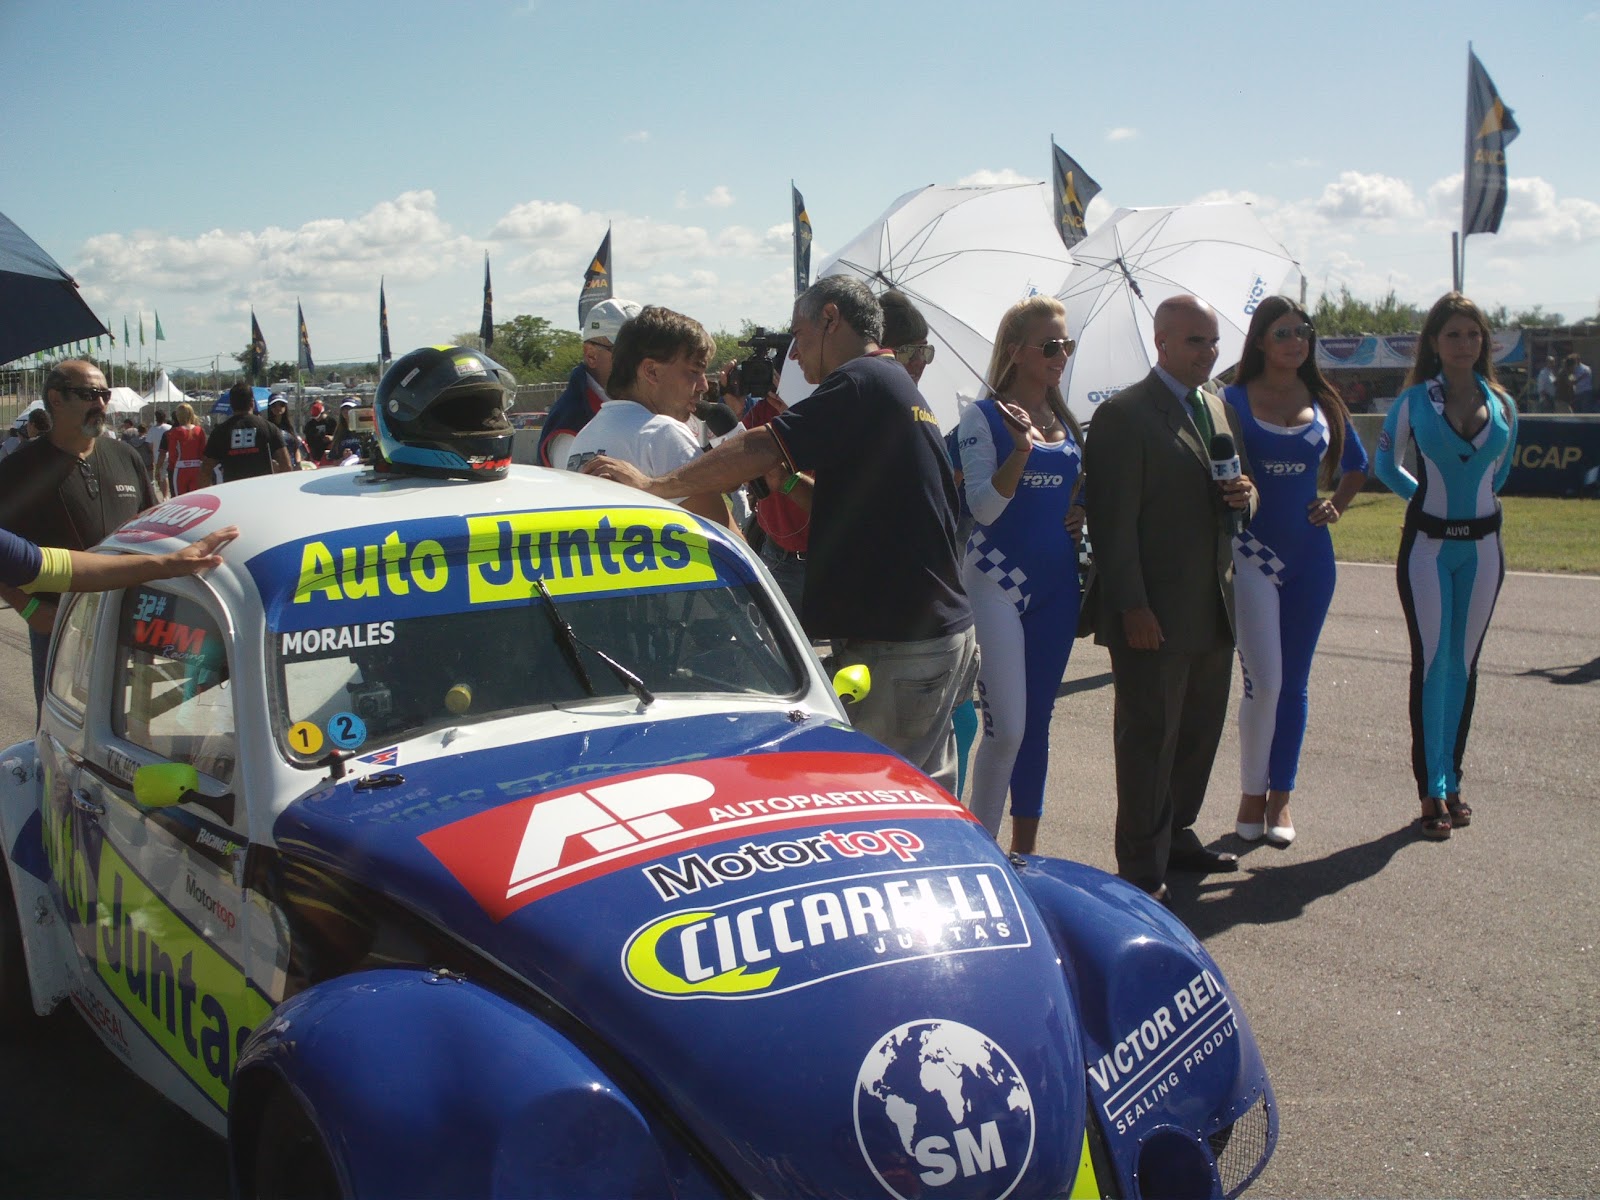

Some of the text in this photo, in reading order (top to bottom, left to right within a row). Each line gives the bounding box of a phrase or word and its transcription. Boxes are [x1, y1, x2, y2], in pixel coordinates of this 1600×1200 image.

[1023, 475, 1063, 486] TOYO
[1264, 463, 1306, 474] TOYO
[293, 514, 692, 604] Auto Juntas
[134, 618, 207, 656] VHM
[281, 621, 396, 656] MORALES
[297, 728, 309, 748] 1
[336, 716, 357, 741] 2
[711, 788, 935, 823] AUTOPARTISTA
[643, 828, 924, 902] Motortop
[185, 874, 236, 930] Motortop
[873, 921, 1012, 954] JUTAS
[1088, 1005, 1177, 1092] VICTOR
[1115, 1071, 1180, 1135] SEALING
[915, 1120, 1007, 1187] SM
